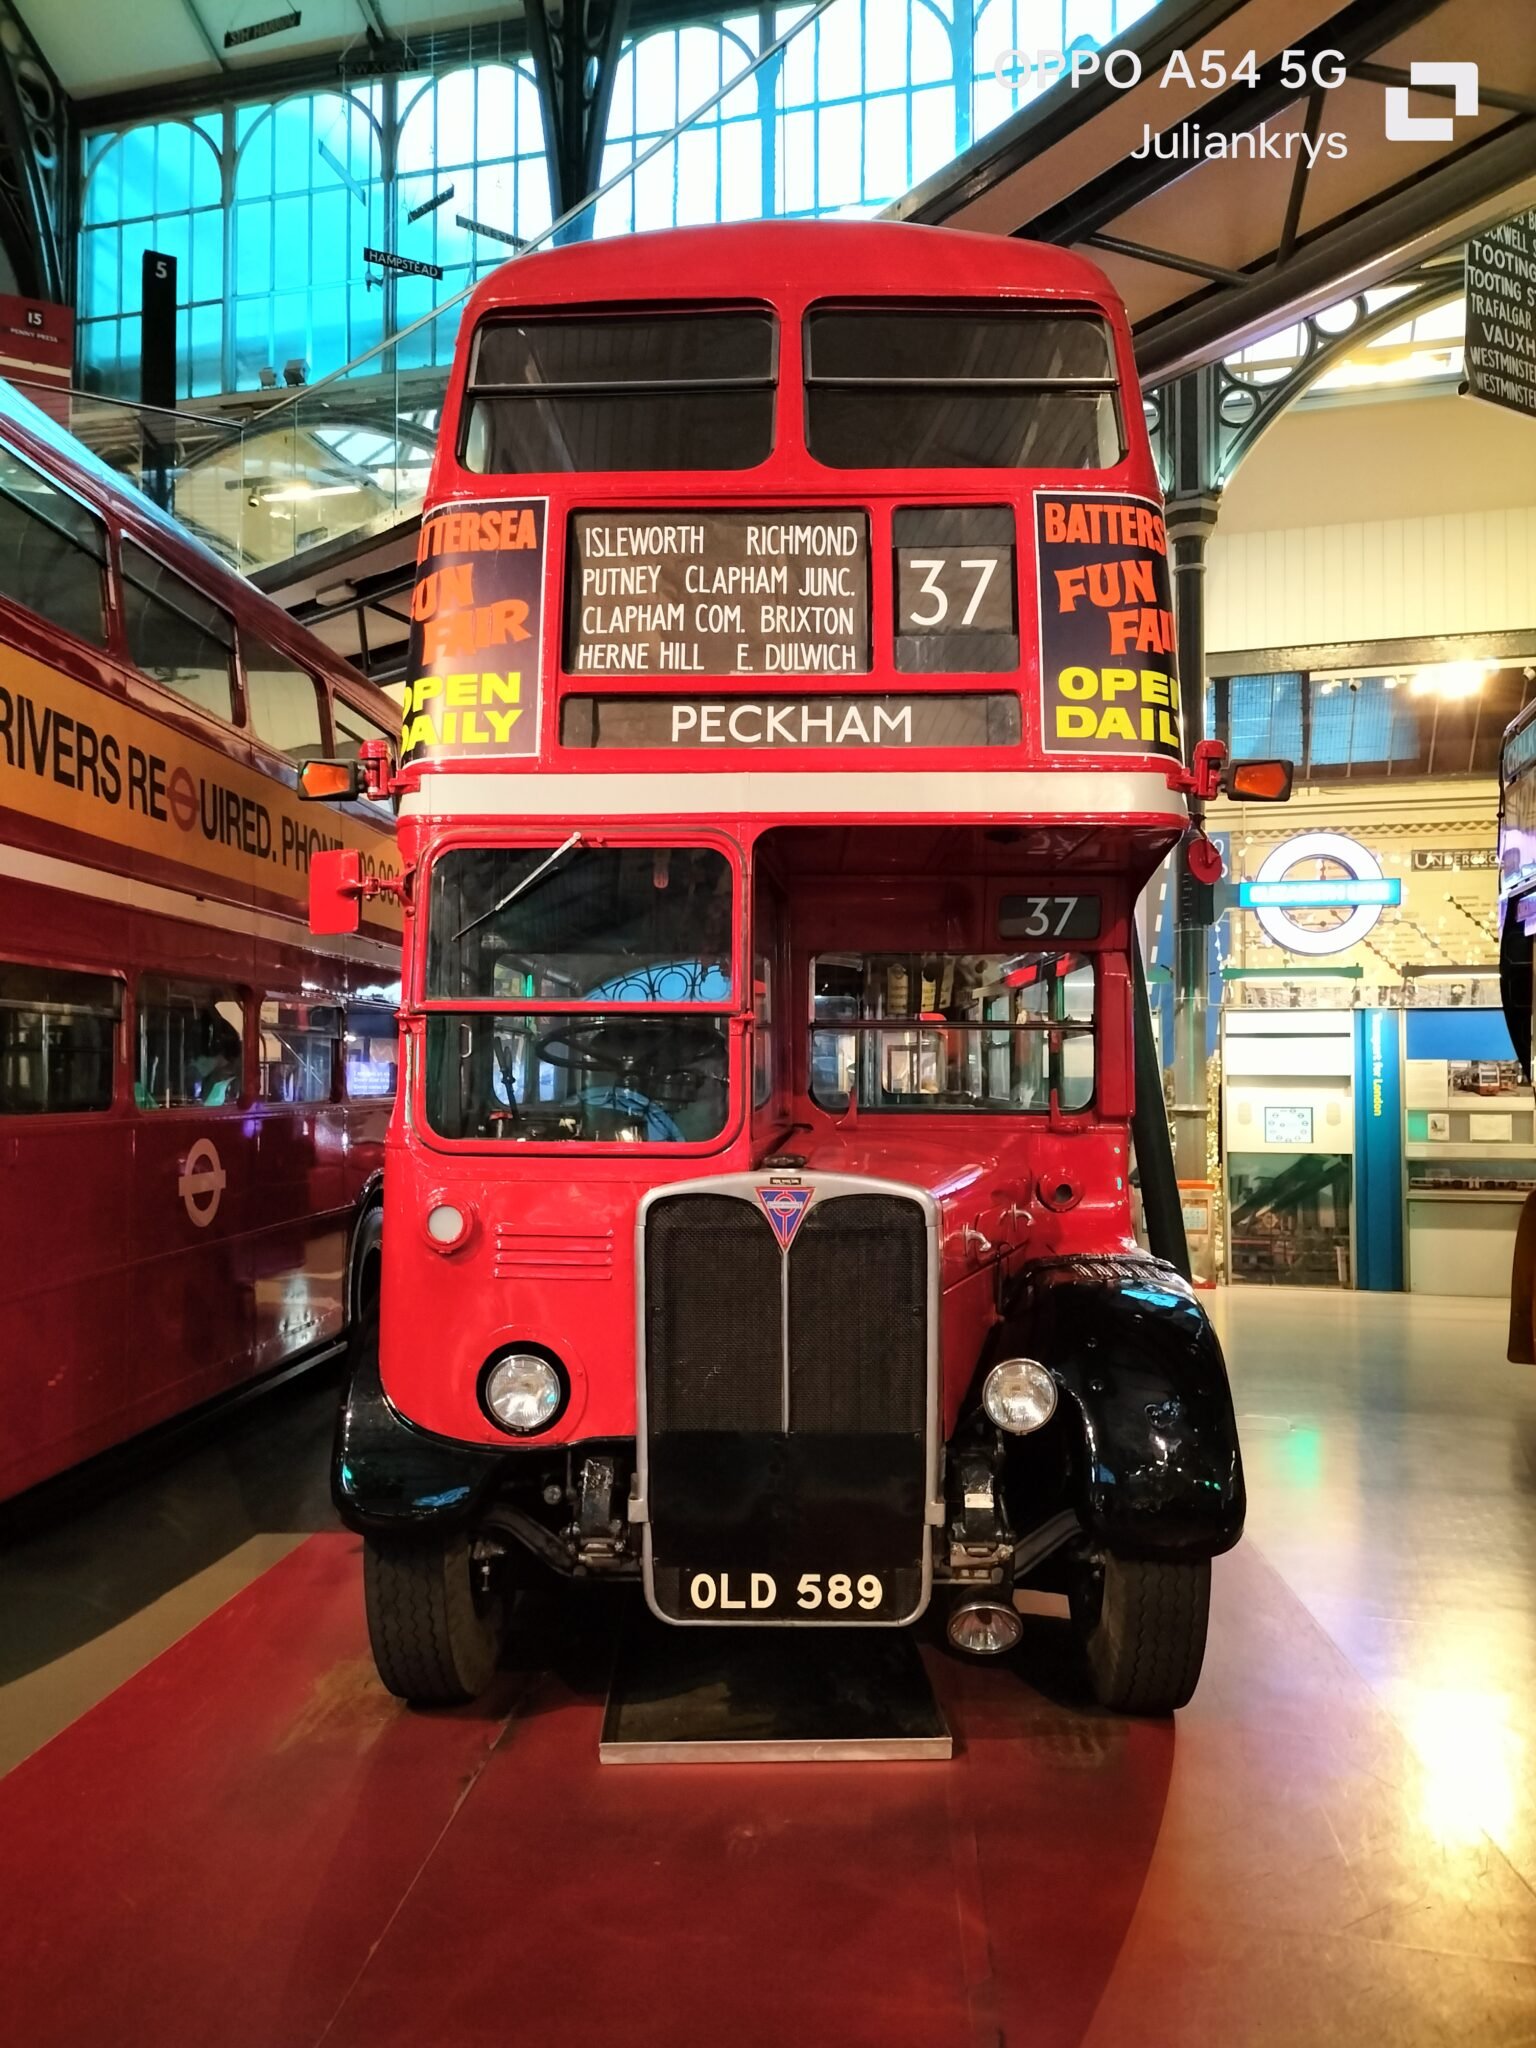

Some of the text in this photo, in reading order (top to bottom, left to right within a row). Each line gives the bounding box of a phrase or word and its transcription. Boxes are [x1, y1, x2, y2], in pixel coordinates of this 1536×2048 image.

[1485, 225, 1528, 254] CKWELL
[155, 261, 168, 279] 5
[369, 251, 438, 278] HAMPSTEAD
[1472, 240, 1536, 283] TOOTING
[1468, 265, 1536, 307] TOOTING S
[28, 311, 43, 326] 15
[1471, 292, 1532, 331] TRAFALGAR
[1470, 346, 1536, 383] WESTMINSTE
[1476, 372, 1536, 410] WESTMINSTE
[417, 510, 537, 566] TTERSEA
[585, 525, 858, 557] ISLEWORTH RICHMOND
[410, 563, 474, 622] UN
[582, 565, 855, 597] PUTNEY CLAPHAM JUNC.
[909, 559, 998, 626] 37
[1054, 560, 1157, 613] FUN
[422, 599, 531, 666] FAIR
[582, 603, 853, 635] CLAPHAM COM. BRIXTON
[1108, 607, 1176, 656] FAI
[578, 641, 856, 671] HERNE HILL E. DULWICH
[671, 704, 912, 744] PECKHAM
[1055, 706, 1184, 749] DAIL
[0, 686, 122, 805] RIVERS
[1025, 897, 1078, 936] 37
[1373, 1078, 1384, 1116] London
[690, 1573, 883, 1610] OLD 589
